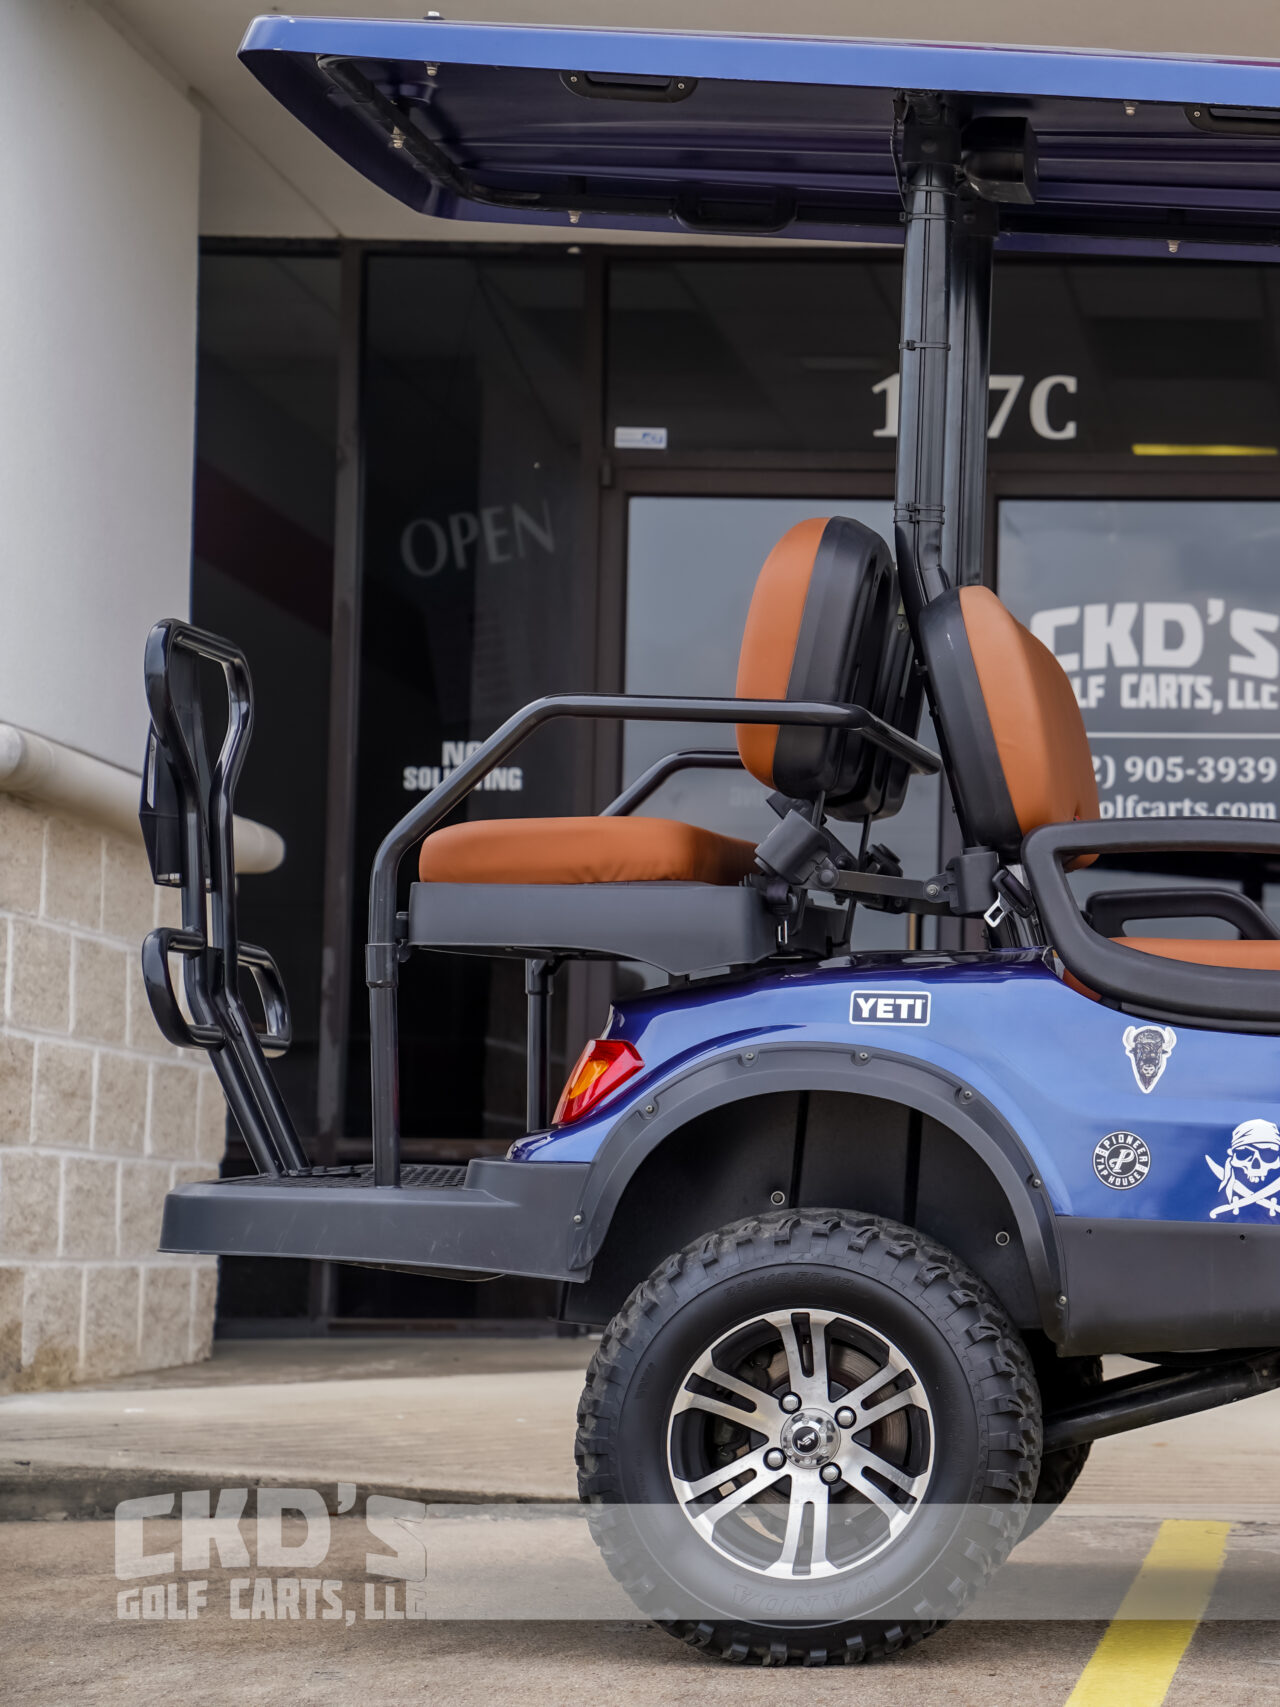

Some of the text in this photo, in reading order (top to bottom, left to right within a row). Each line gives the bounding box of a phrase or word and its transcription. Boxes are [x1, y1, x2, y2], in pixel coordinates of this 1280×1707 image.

[871, 373, 1078, 440] 17C
[401, 498, 556, 578] OPEN
[1030, 597, 1280, 680] CKD'S
[1071, 673, 1280, 715] LF CARTS, LLC
[403, 766, 523, 791] SOLING
[1124, 755, 1279, 784] 905-3939
[1099, 795, 1277, 819] olfcarts.com
[856, 997, 924, 1019] YETI
[1103, 1134, 1148, 1162] PIONEER
[1096, 1157, 1109, 1176] TAP
[1108, 1171, 1141, 1186] HOUSE
